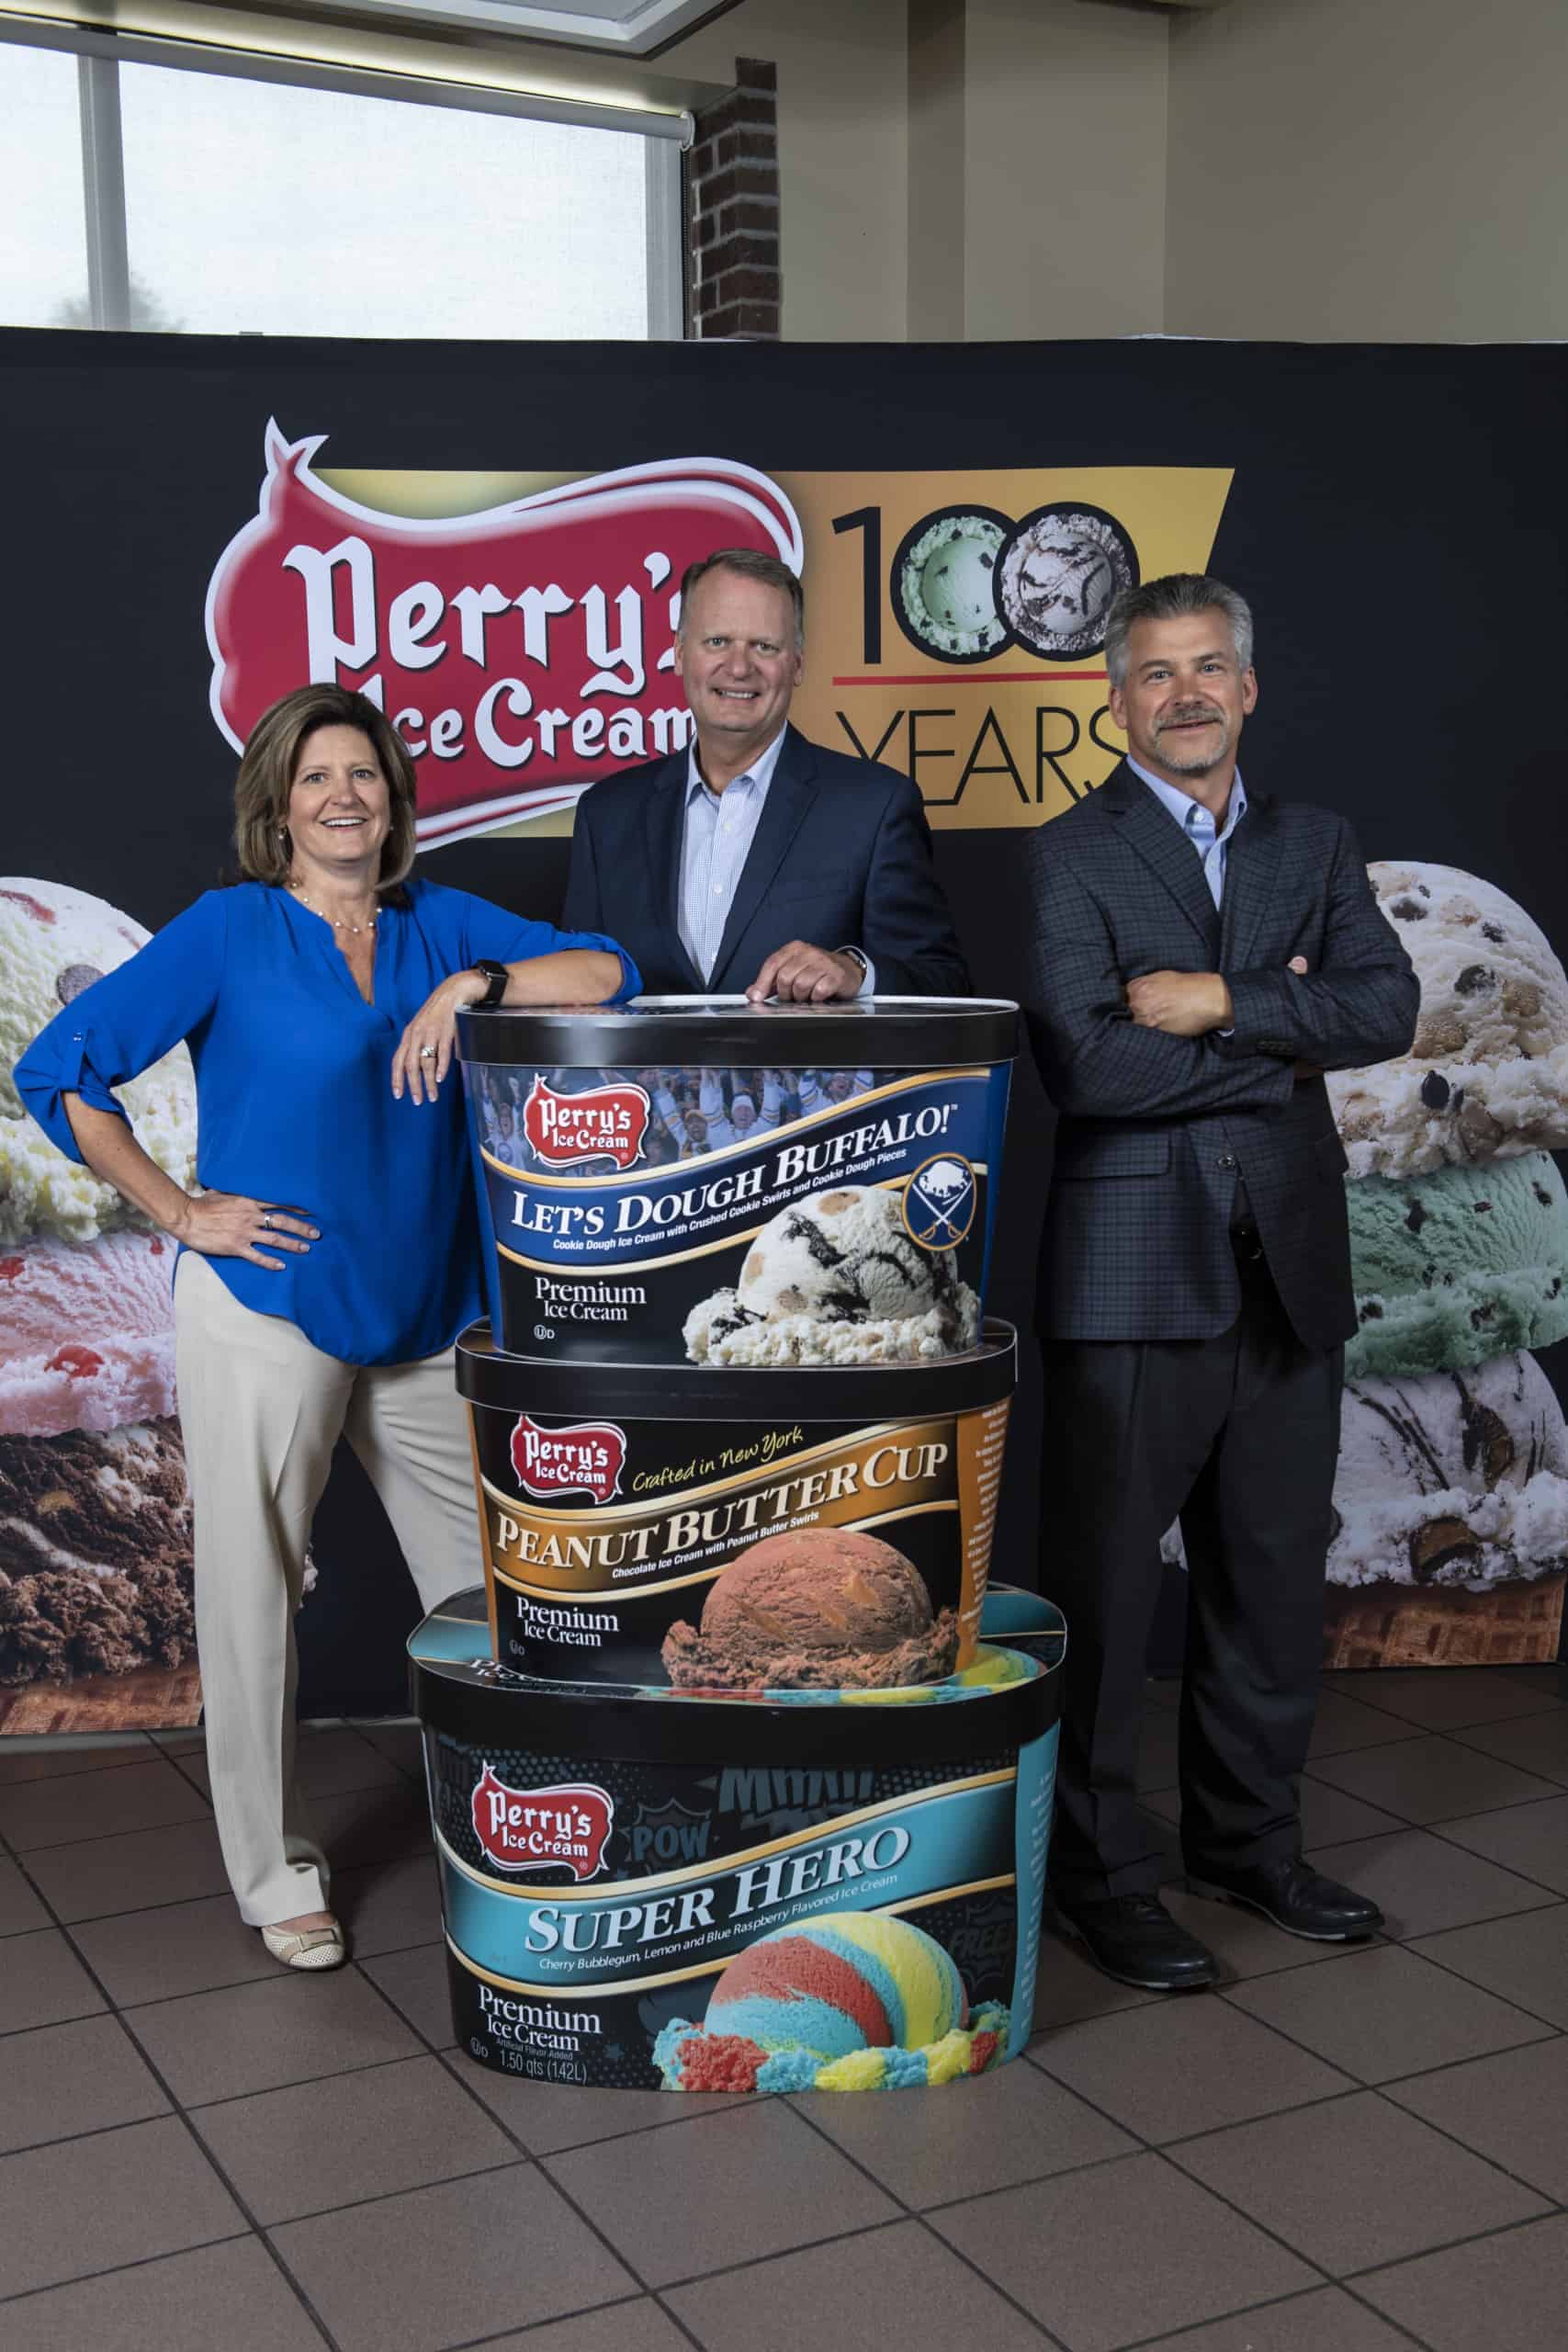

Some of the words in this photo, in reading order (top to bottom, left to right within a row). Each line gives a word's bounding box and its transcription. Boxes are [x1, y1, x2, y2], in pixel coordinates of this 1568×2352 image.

[831, 502, 1140, 664] 100
[360, 673, 464, 758] ce
[475, 678, 697, 767] Cream
[537, 1098, 631, 1139] Perry's
[552, 1127, 574, 1148] Ice
[576, 1129, 628, 1148] Cream
[511, 1191, 604, 1235] LET'S
[614, 1164, 766, 1233] DOUGH
[772, 1103, 950, 1187] BUFFALO!
[553, 1239, 584, 1250] Cookie
[586, 1240, 616, 1250] Dough
[618, 1238, 633, 1248] Ice
[634, 1231, 665, 1245] Cream
[667, 1224, 688, 1238] with
[689, 1210, 728, 1231] Crushed
[728, 1200, 761, 1218] Cookie
[761, 1189, 791, 1206] Swirls
[793, 1180, 811, 1195] and
[812, 1168, 844, 1187] Cookie
[845, 1159, 875, 1178] Dough
[877, 1148, 907, 1164] Pieces
[535, 1276, 647, 1304] Premium
[544, 1300, 568, 1317] Ice
[570, 1303, 628, 1321] Cream
[522, 1430, 608, 1470] Perry's
[632, 1459, 697, 1492] Crafted
[699, 1461, 716, 1476] in
[719, 1442, 759, 1467] New
[761, 1426, 804, 1463] York
[536, 1459, 555, 1479] Ice
[557, 1463, 605, 1485] Cream
[497, 1511, 660, 1569] PEANUT
[663, 1462, 860, 1554] BUTTER
[862, 1443, 949, 1488] CUP
[612, 1563, 657, 1579] Chocolate
[658, 1558, 672, 1570] Ice
[673, 1549, 704, 1565] Cream
[705, 1542, 726, 1556] with
[727, 1531, 759, 1548] Peanut
[761, 1520, 788, 1537] Butter
[789, 1510, 819, 1529] Swirls
[516, 1595, 619, 1632] Premium
[524, 1620, 545, 1640] Ice
[547, 1626, 603, 1646] Cream
[486, 1790, 592, 1841] Perry's
[502, 1826, 526, 1849] Ice
[528, 1831, 588, 1858] Cream
[631, 1821, 712, 1861] POW
[525, 1887, 715, 1953] SUPER
[728, 1826, 909, 1918] HERO
[539, 1958, 574, 1972] Cherry
[645, 1943, 682, 1960] Lemon
[683, 1935, 705, 1950] and
[706, 1928, 731, 1944] Blue
[734, 1910, 788, 1934] Raspberry
[792, 1891, 840, 1915] Flavored
[841, 1885, 859, 1898] Ice
[860, 1874, 898, 1893] Cream
[478, 1984, 603, 2034] Premium
[487, 2014, 512, 2038] Ice
[514, 2023, 580, 2052] Cream
[500, 2050, 524, 2072] 1.50
[525, 2059, 545, 2076] qts
